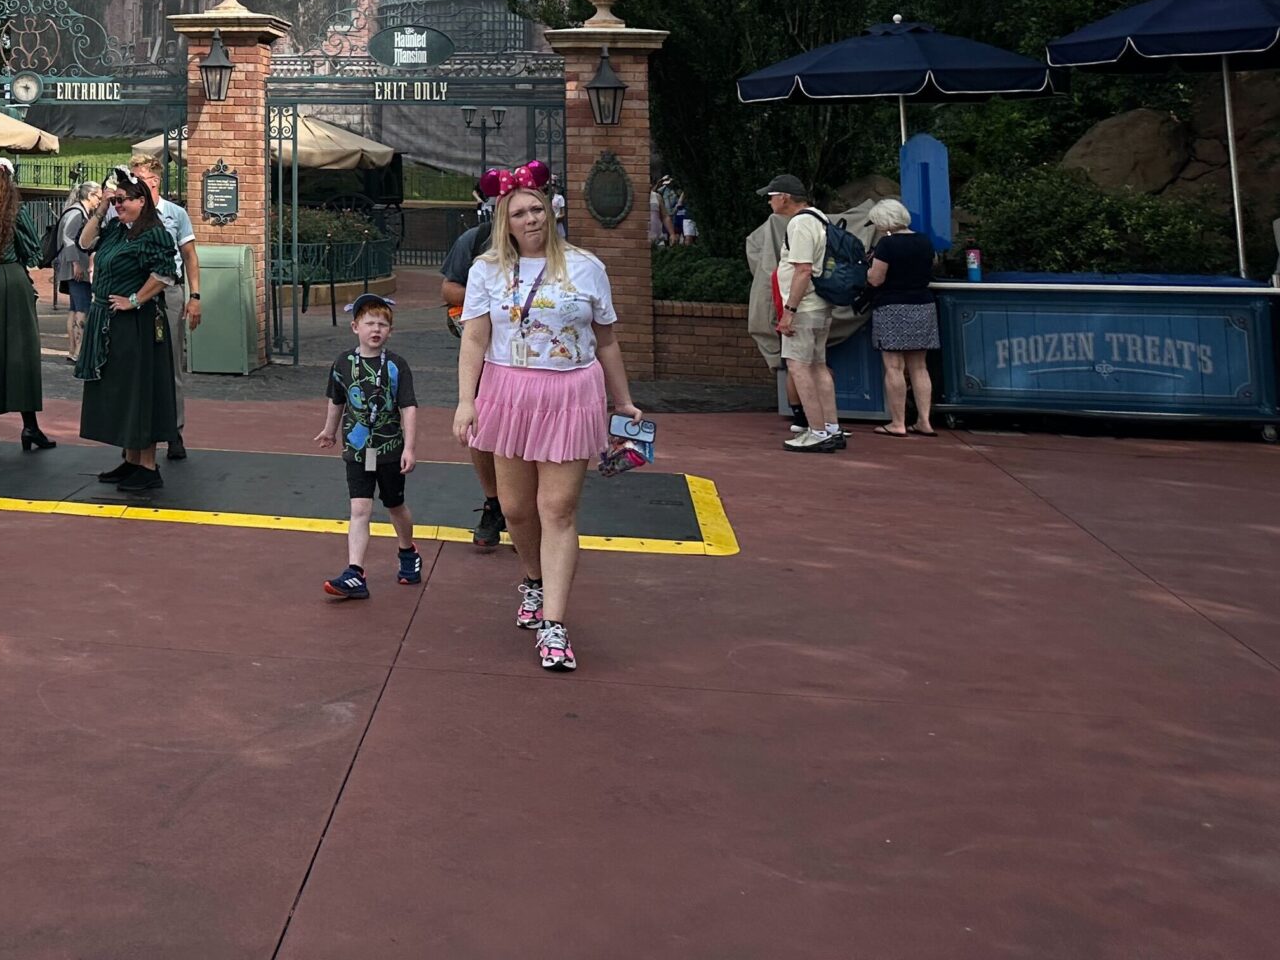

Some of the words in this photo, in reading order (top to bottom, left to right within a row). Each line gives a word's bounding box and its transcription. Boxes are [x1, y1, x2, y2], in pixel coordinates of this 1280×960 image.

[394, 31, 427, 47] Haunted
[393, 48, 427, 66] Mansion
[56, 82, 120, 100] ENTRANCE
[375, 82, 407, 100] EXIT
[414, 82, 448, 100] ONLY
[996, 332, 1094, 368] FROZEN
[1104, 333, 1213, 374] TREATS
